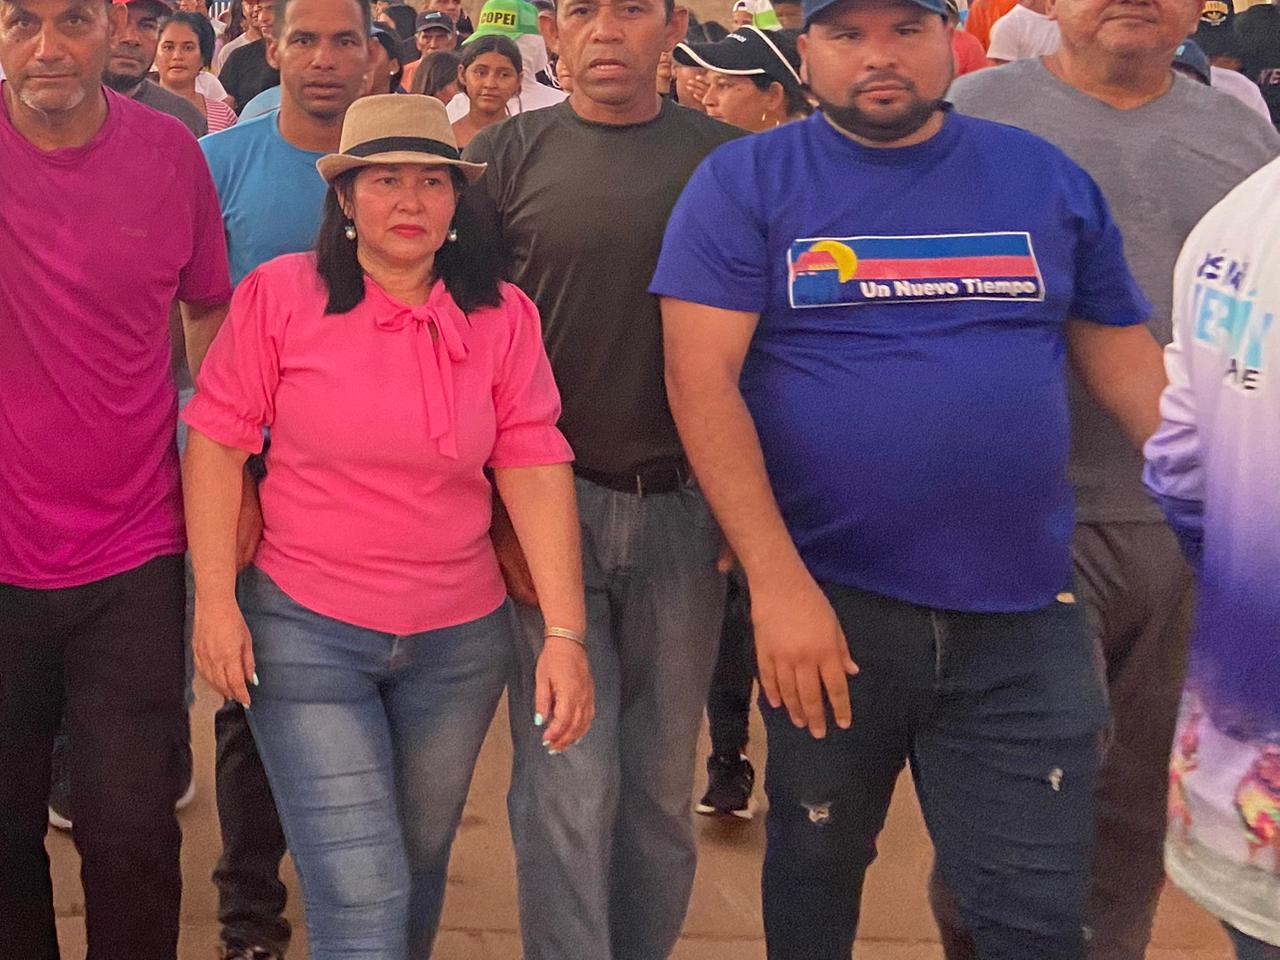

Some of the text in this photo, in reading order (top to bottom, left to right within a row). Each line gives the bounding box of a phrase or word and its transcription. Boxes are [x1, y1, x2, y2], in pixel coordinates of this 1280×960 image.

[480, 12, 516, 26] COPEI
[859, 278, 1037, 298] Un Nuevo Tiempo
